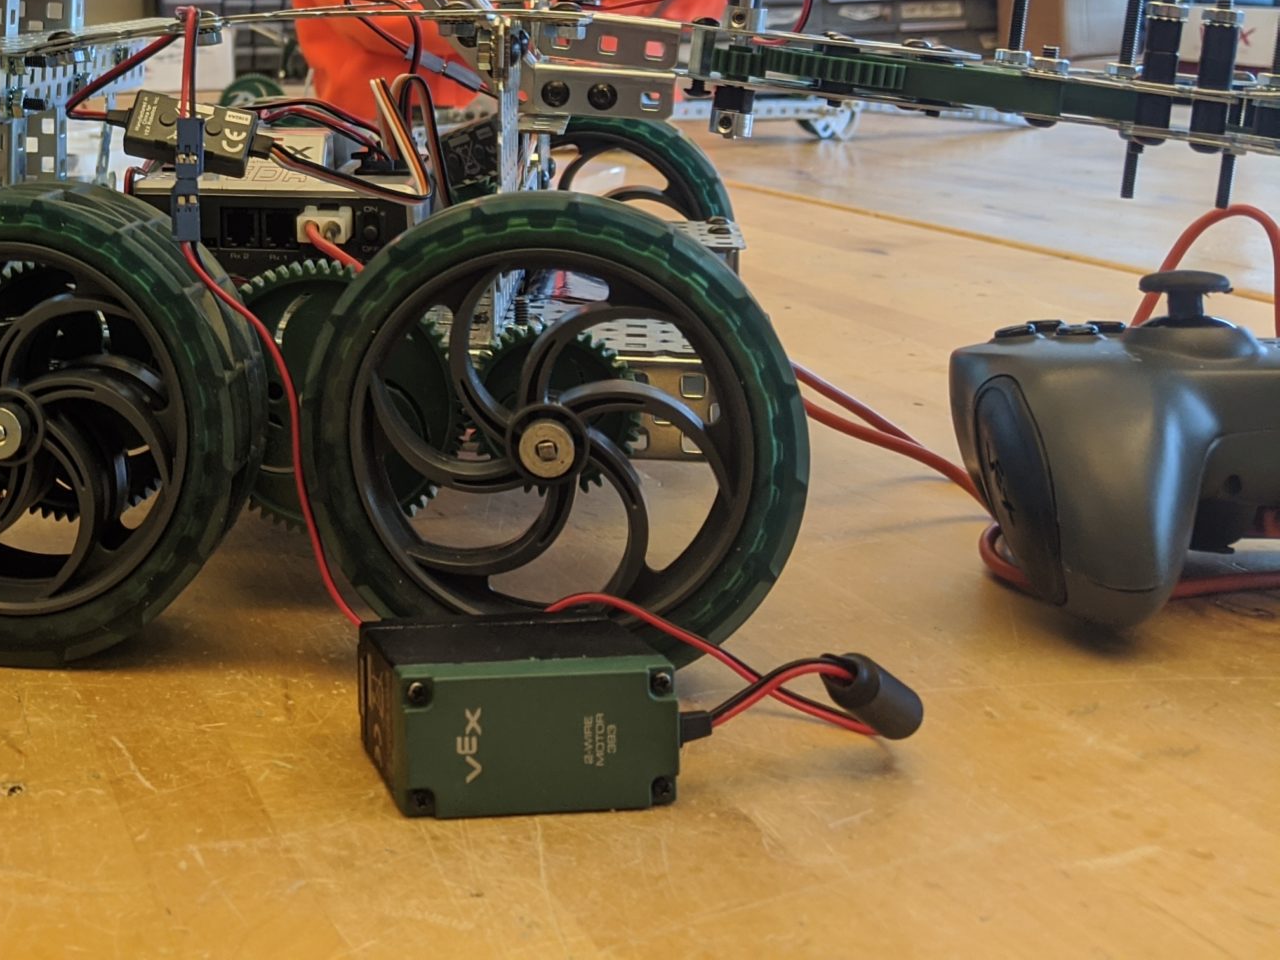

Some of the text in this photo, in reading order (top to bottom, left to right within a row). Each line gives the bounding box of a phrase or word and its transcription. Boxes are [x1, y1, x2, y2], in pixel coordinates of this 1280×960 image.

[456, 707, 483, 783] VEX
[583, 715, 594, 765] 2-WIRE
[595, 712, 605, 767] MOTOR
